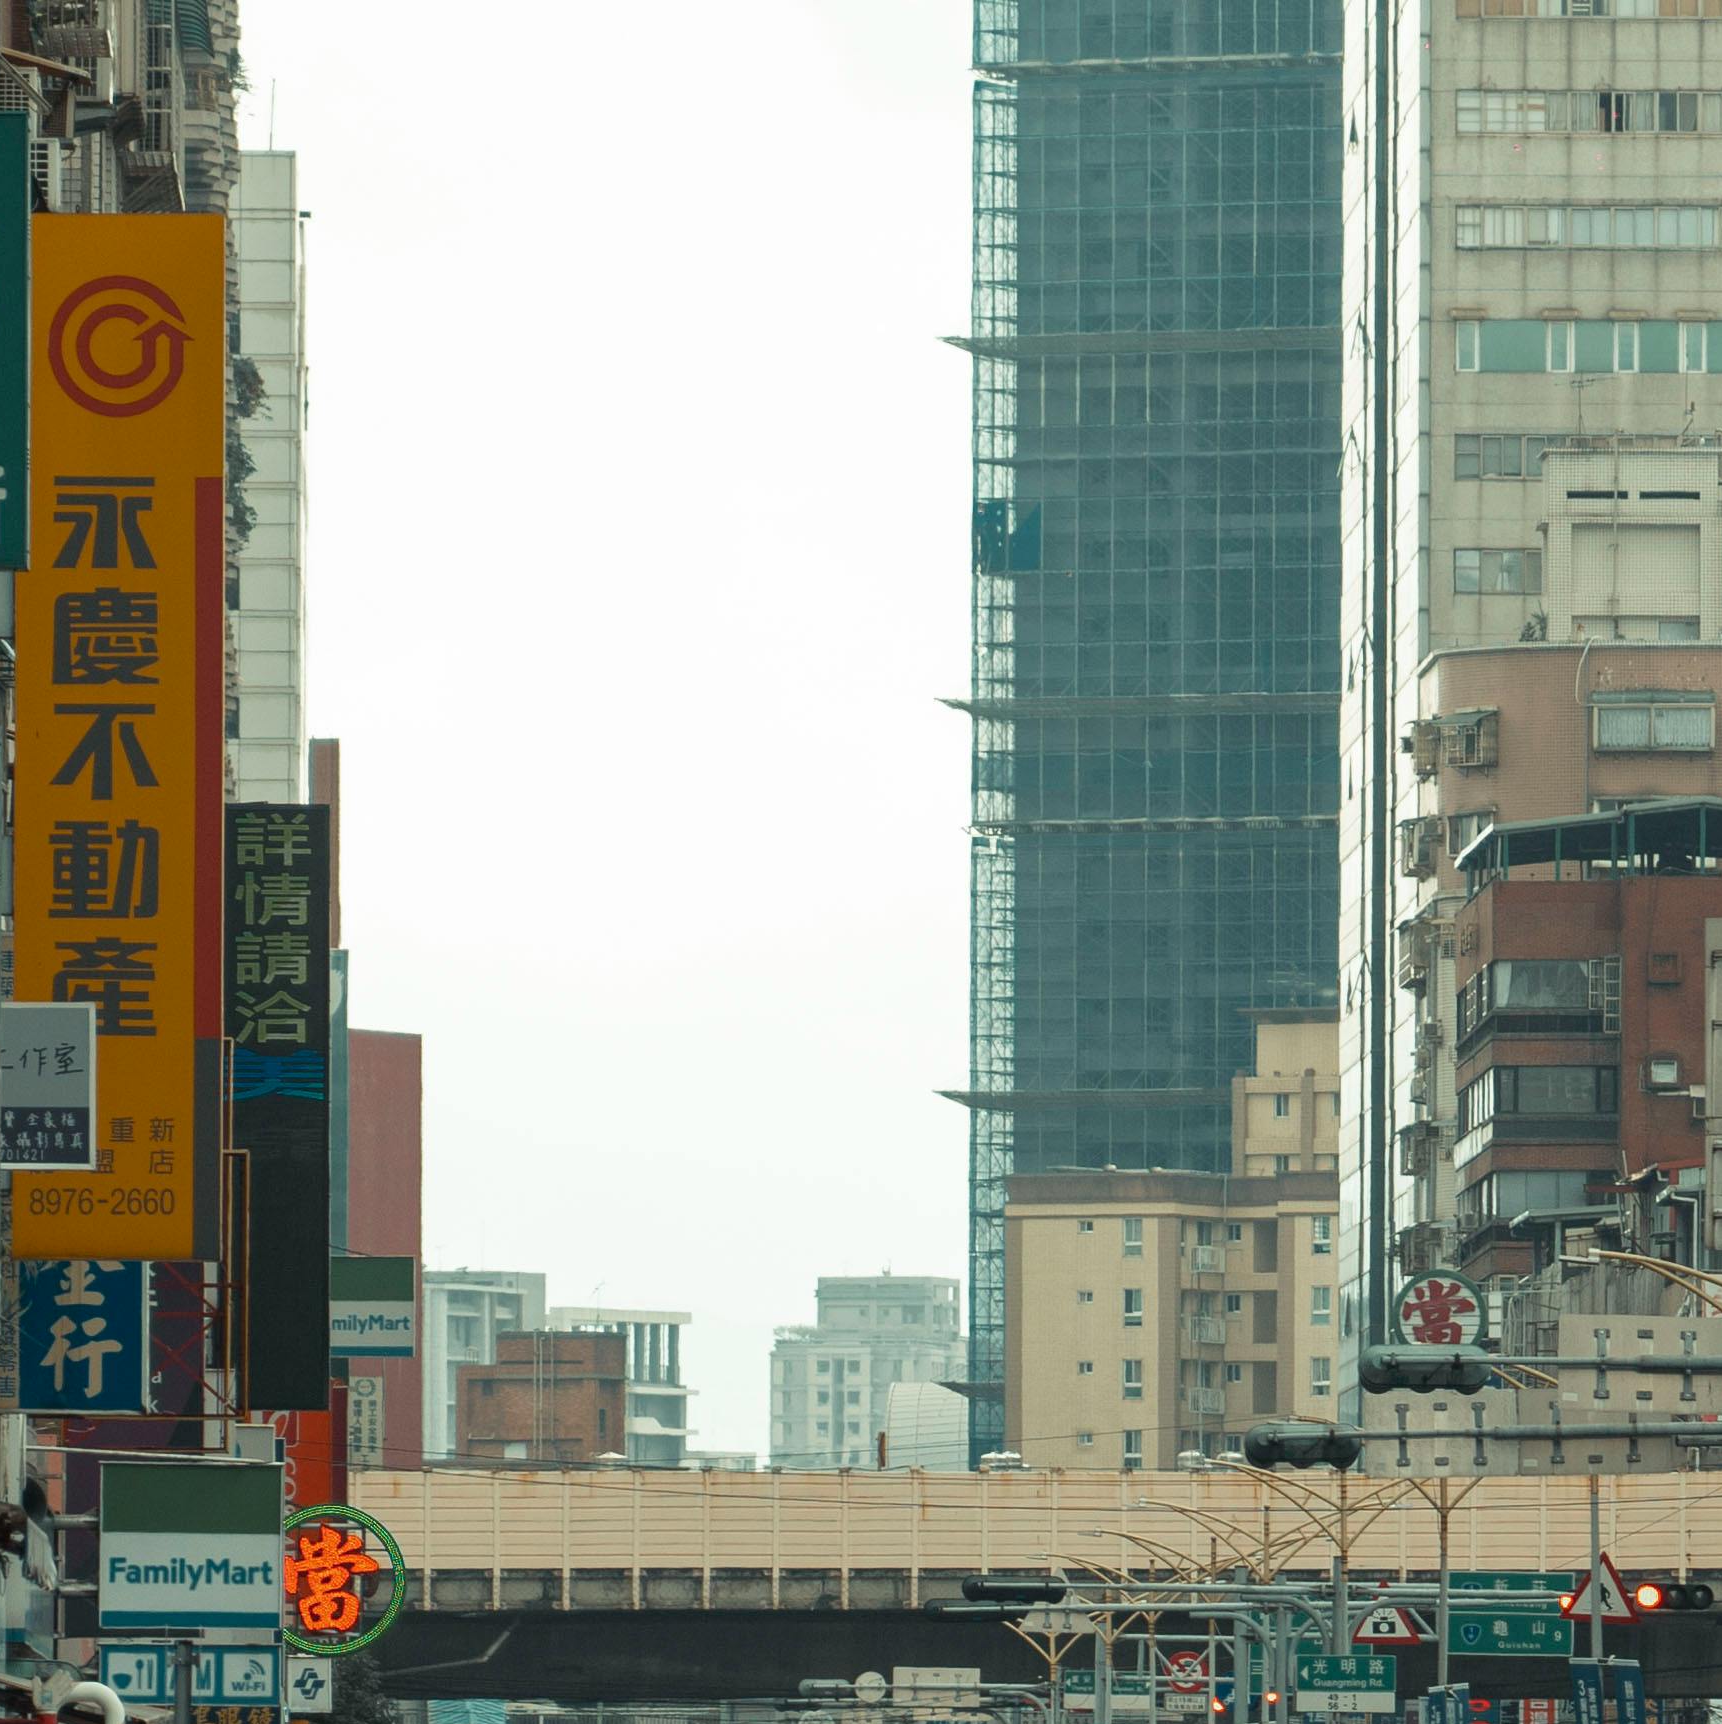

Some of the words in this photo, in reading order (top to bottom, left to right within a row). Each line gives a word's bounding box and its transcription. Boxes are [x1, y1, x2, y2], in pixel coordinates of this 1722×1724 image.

[48, 475, 161, 1037] 永慶不動產
[234, 812, 312, 1044] 詳情請洽
[29, 1187, 176, 1216] 8976-2660
[108, 1557, 274, 1592] FamilyMart
[1313, 1659, 1385, 1675] 光明路
